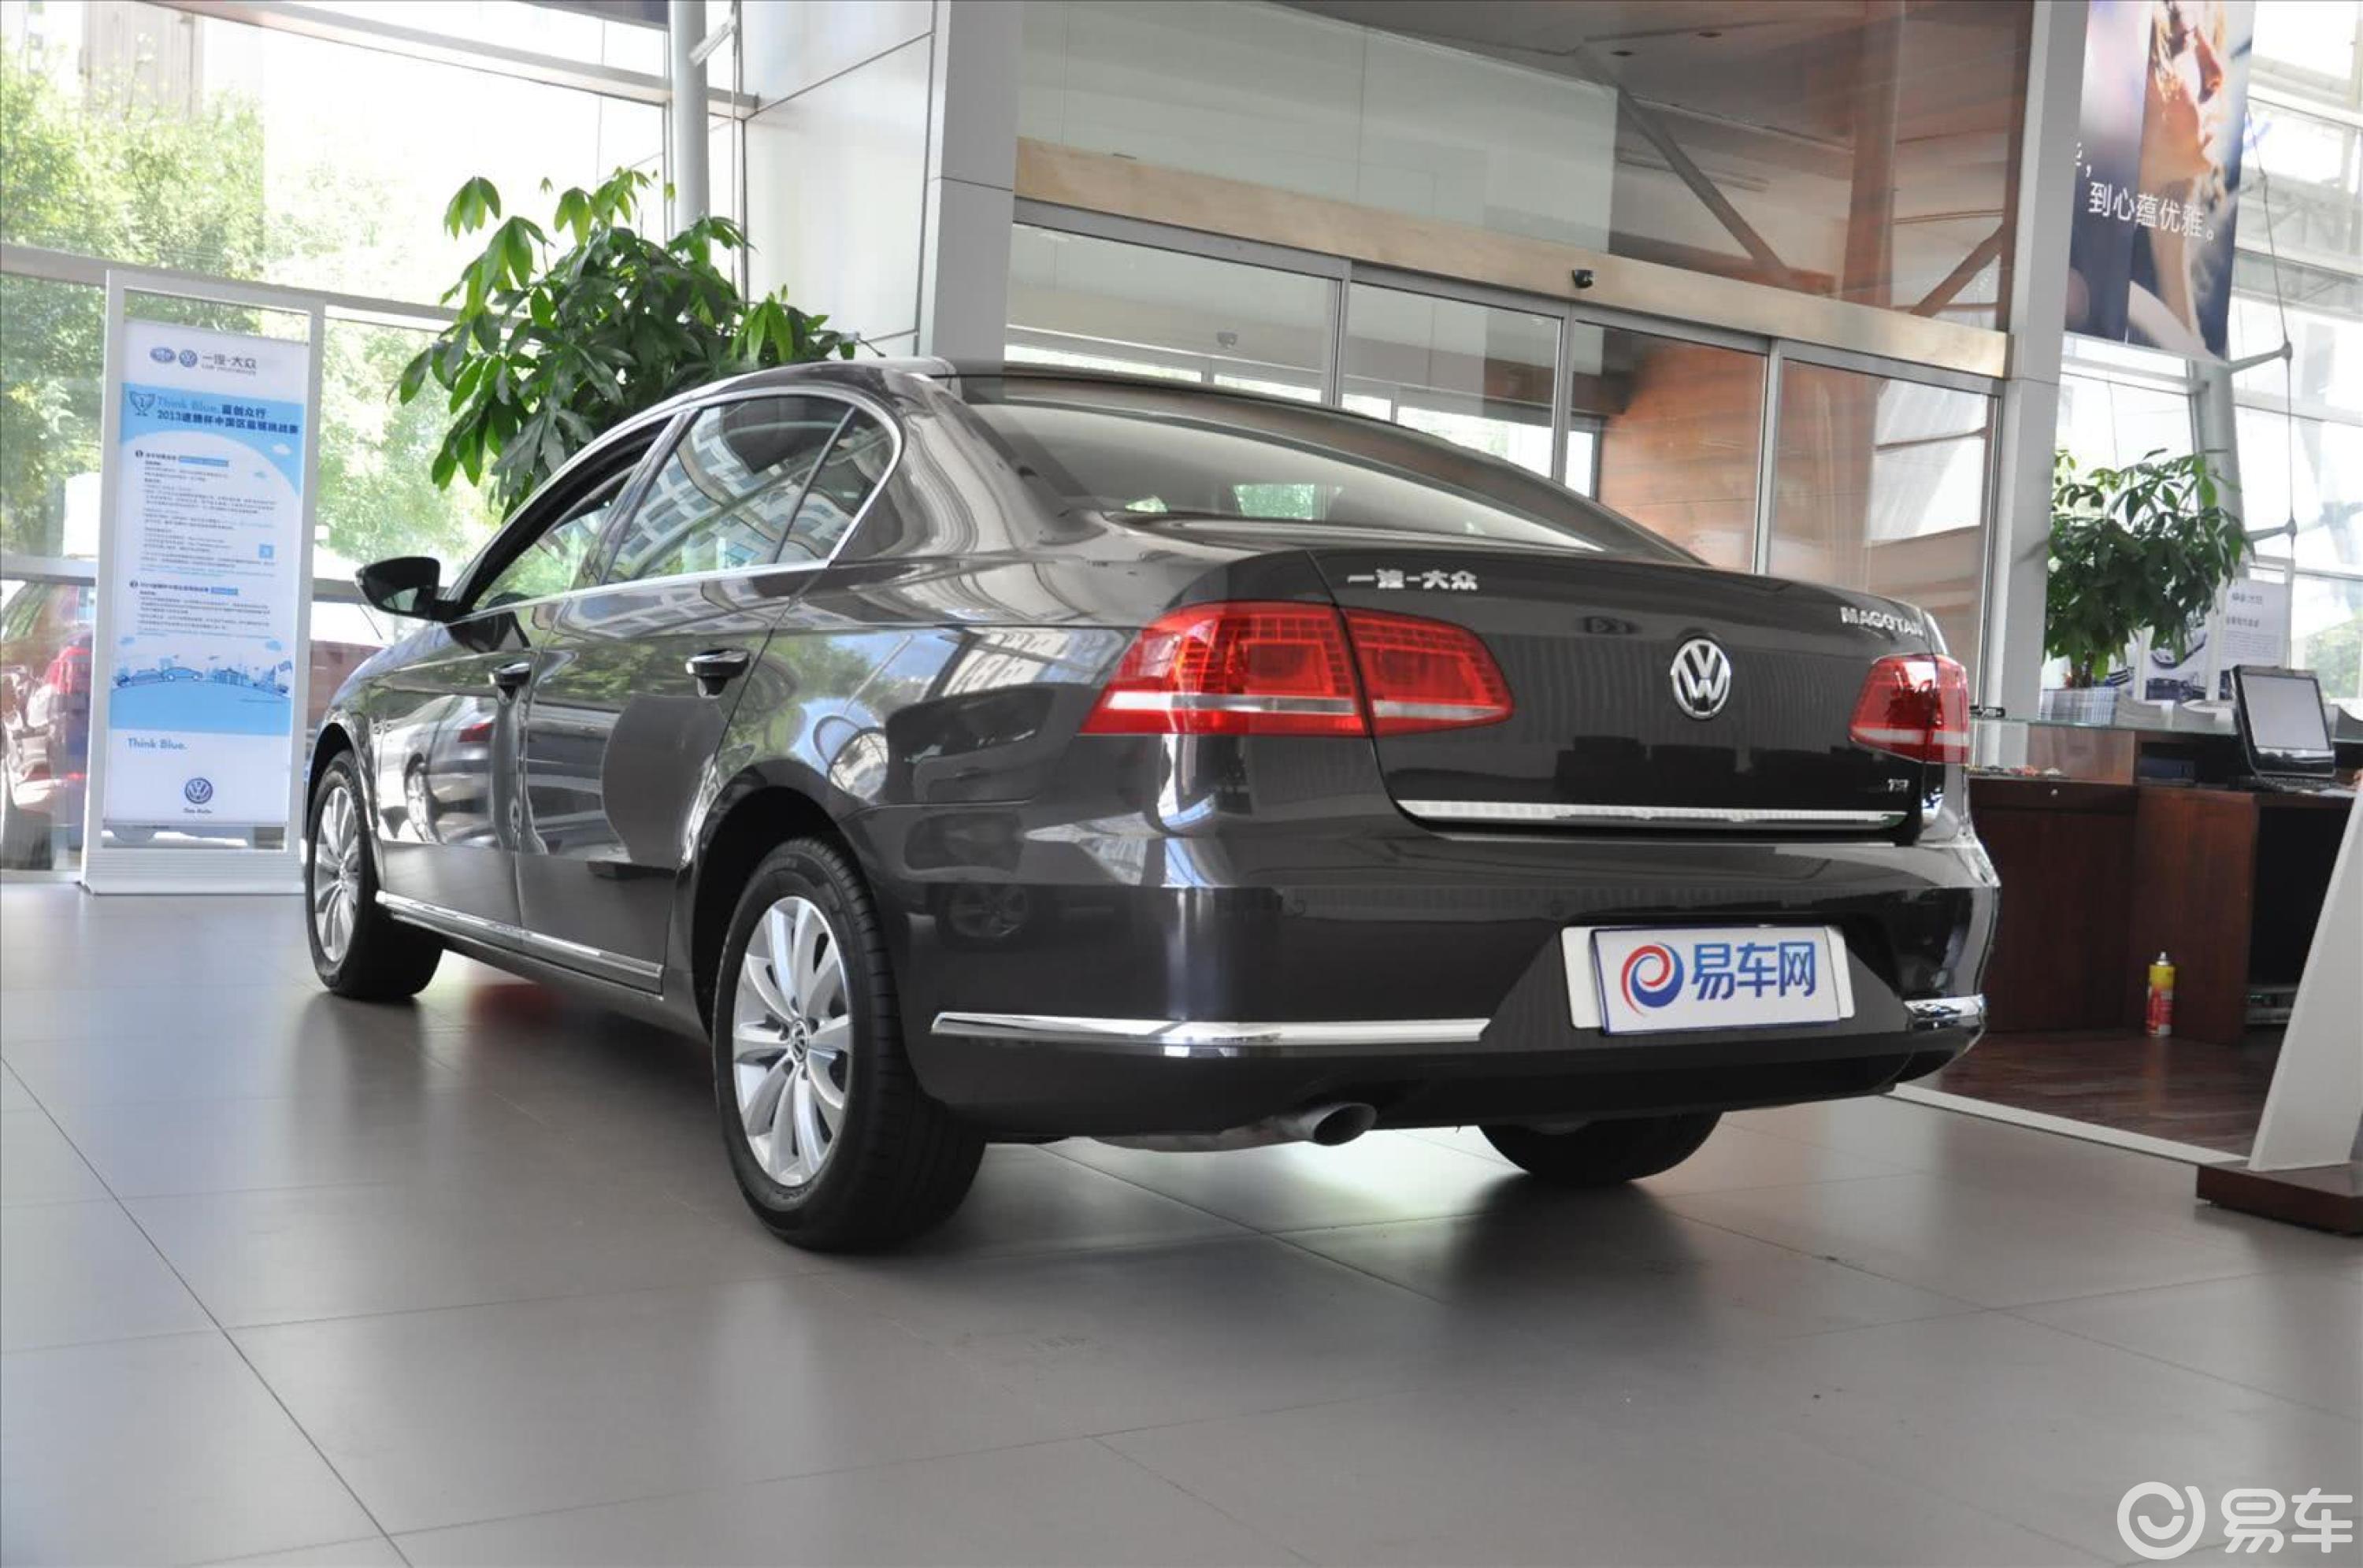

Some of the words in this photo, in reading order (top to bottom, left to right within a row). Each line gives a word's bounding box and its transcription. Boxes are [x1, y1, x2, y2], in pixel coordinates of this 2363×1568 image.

[128, 738, 155, 749] Think
[1691, 942, 1816, 1000] 易车网
